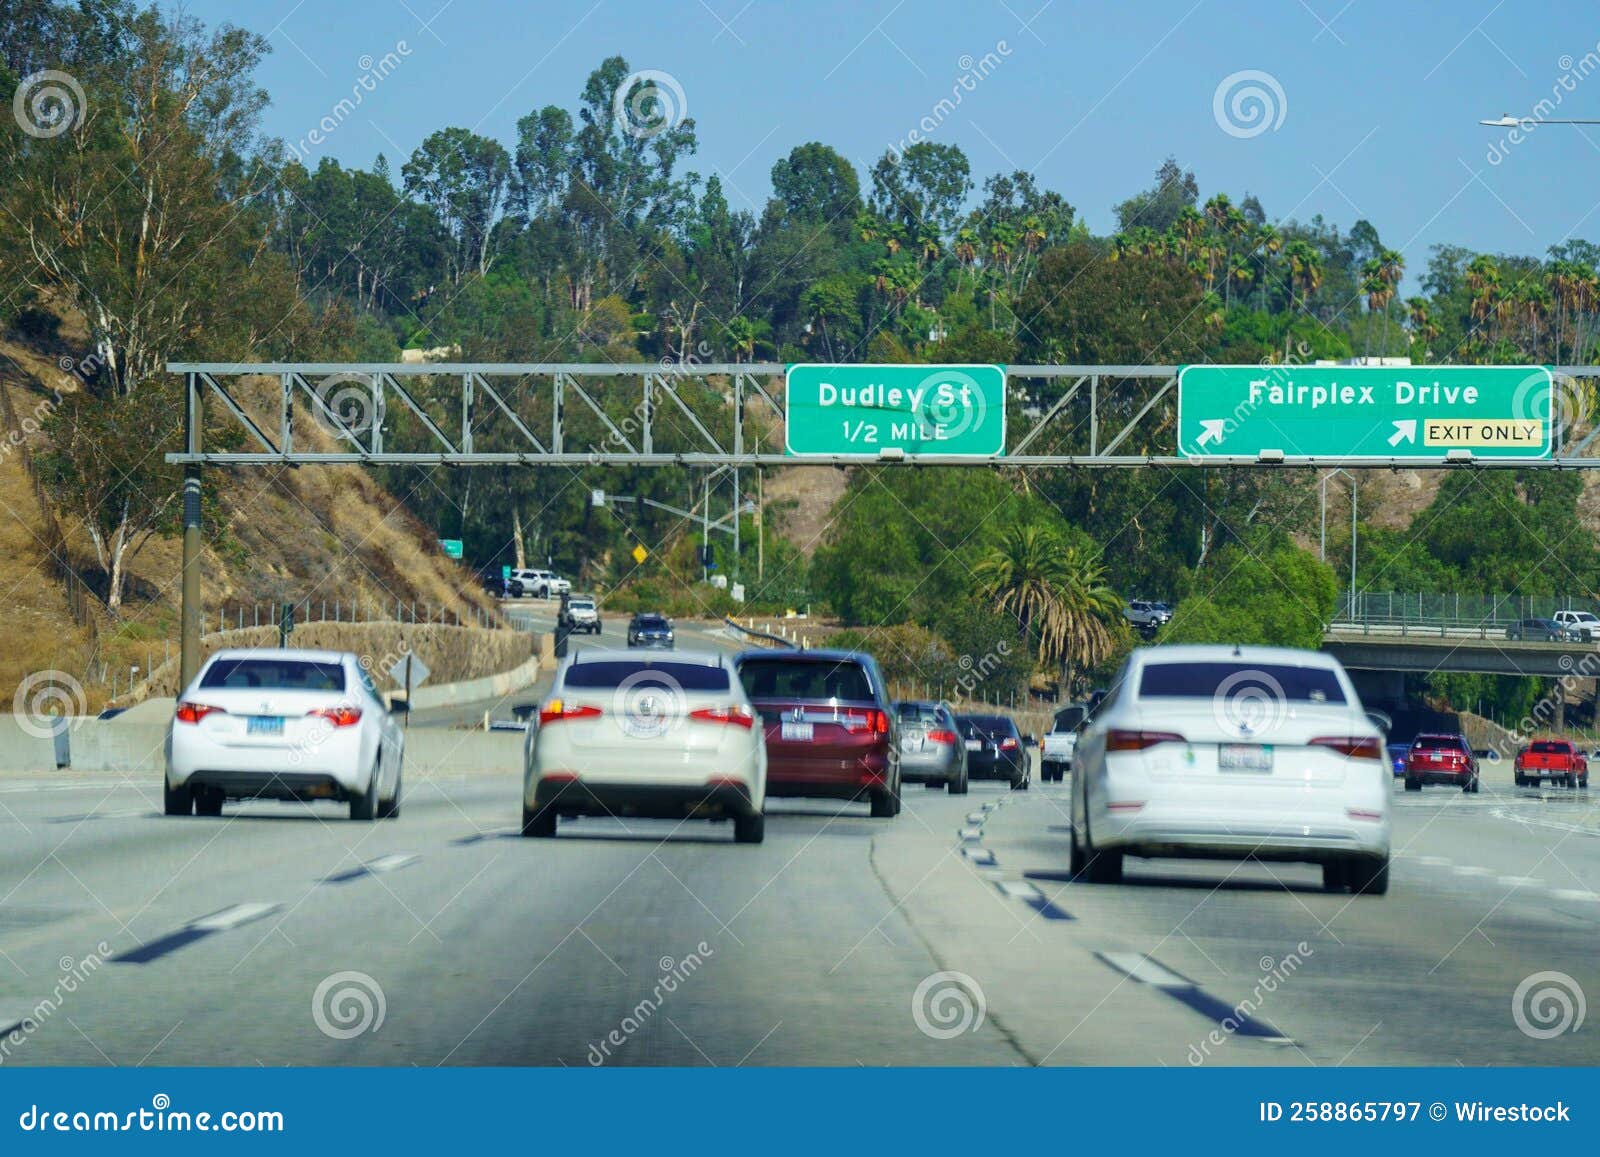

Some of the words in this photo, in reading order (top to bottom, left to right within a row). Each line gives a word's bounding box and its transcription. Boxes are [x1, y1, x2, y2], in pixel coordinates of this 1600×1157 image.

[819, 383, 924, 412] Dudley
[937, 383, 972, 408] St
[1249, 381, 1375, 408] Fairplex
[1395, 381, 1480, 405] Drive
[843, 421, 878, 443] 1/2
[891, 423, 949, 441] MILE
[1430, 425, 1473, 441] EXIT
[1481, 425, 1536, 441] ONLY
